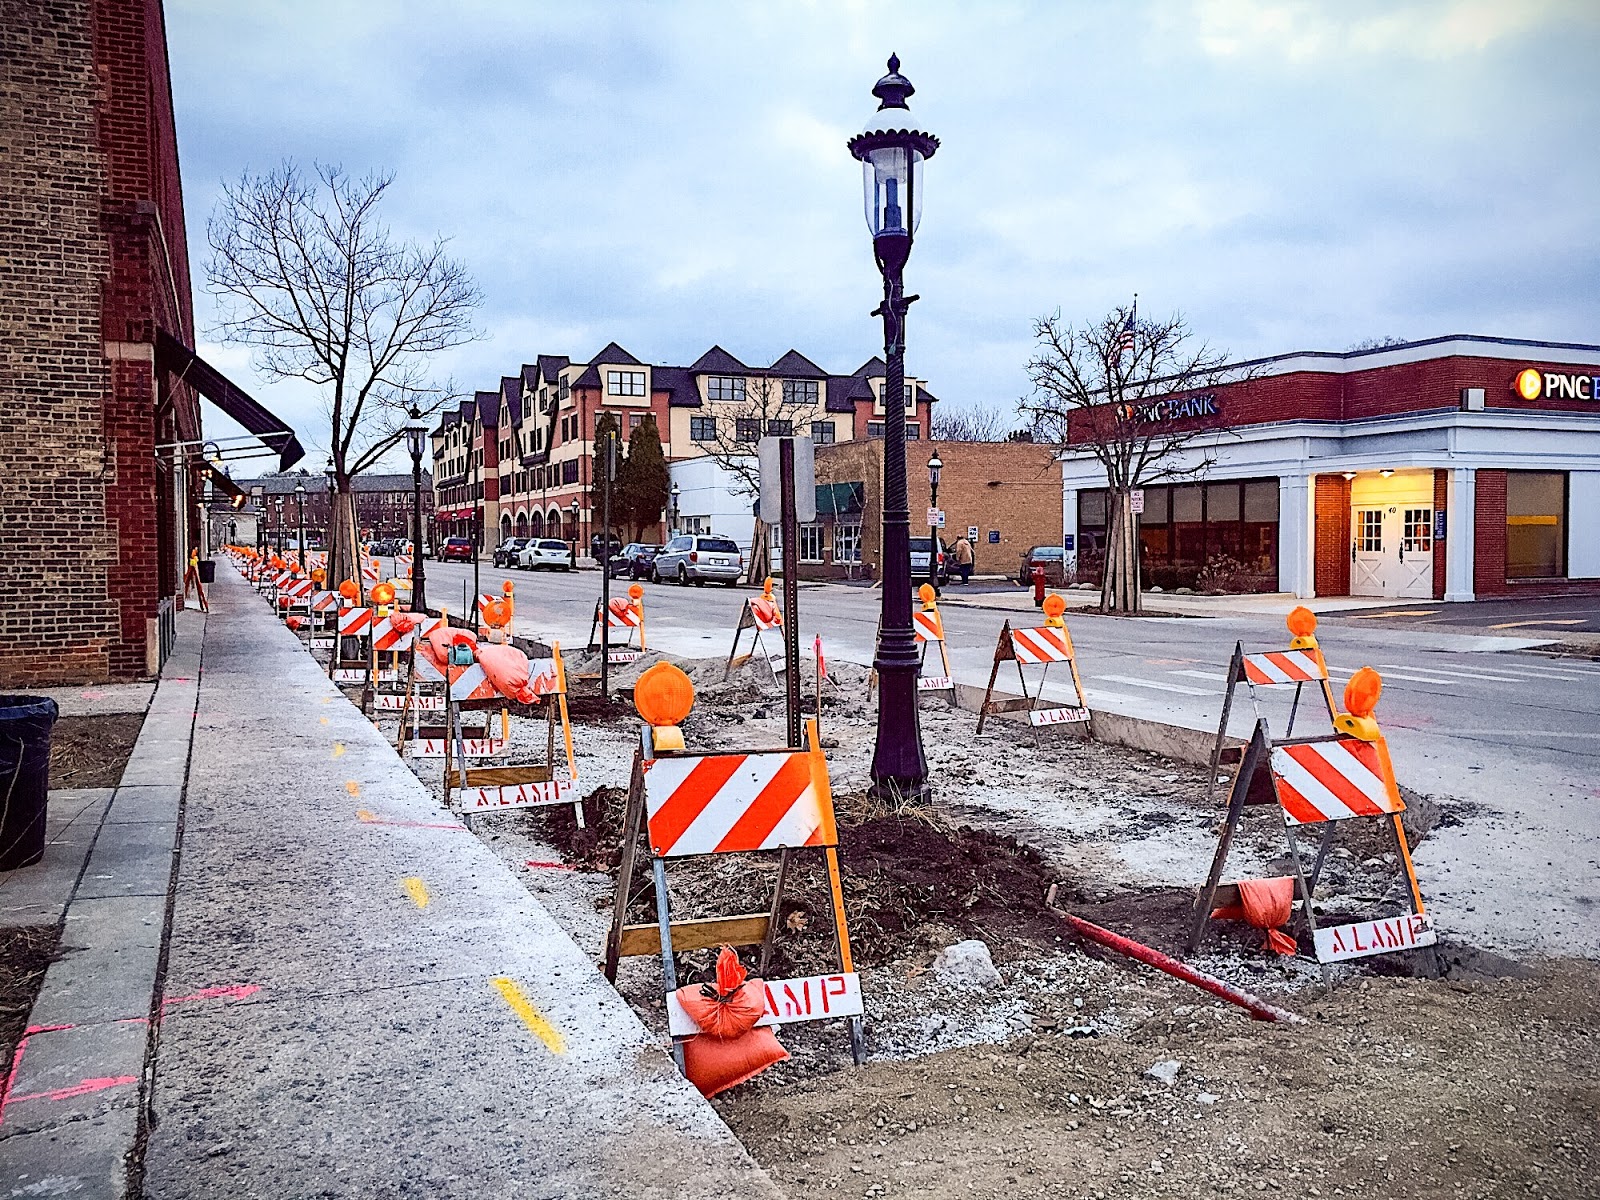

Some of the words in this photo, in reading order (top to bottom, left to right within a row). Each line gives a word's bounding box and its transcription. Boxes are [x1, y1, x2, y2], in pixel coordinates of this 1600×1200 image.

[1543, 373, 1591, 400] PNC
[1135, 401, 1166, 424] NC
[1167, 394, 1216, 420] BANK
